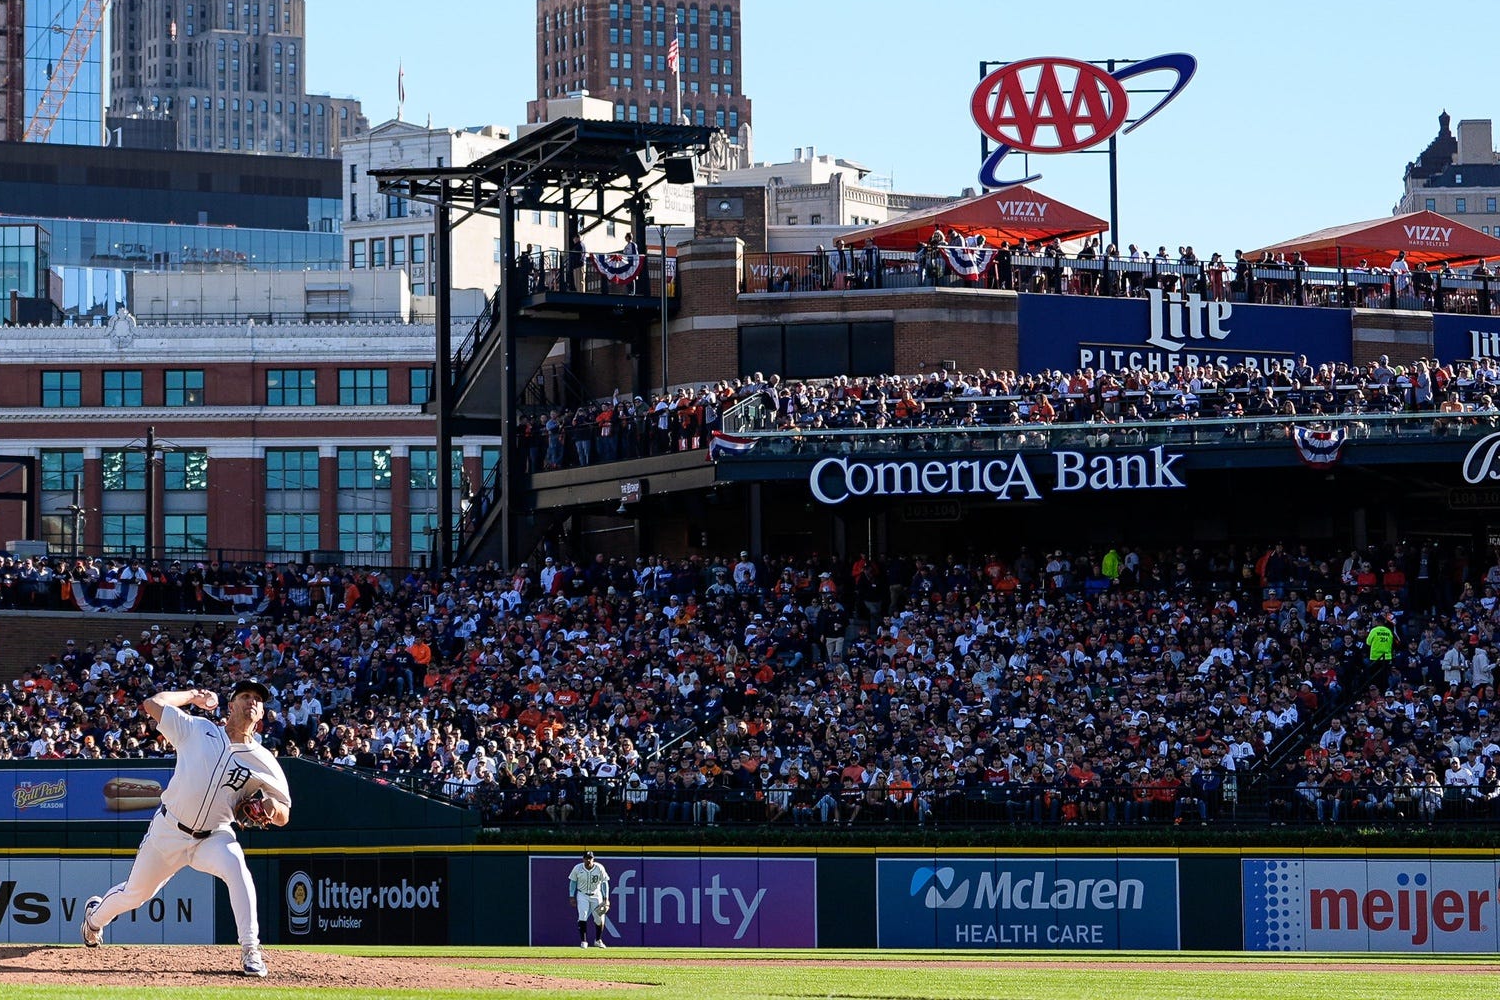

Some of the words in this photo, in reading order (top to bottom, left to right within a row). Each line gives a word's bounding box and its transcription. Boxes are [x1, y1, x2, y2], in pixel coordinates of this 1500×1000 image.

[985, 61, 1115, 149] AAA
[996, 201, 1048, 216] VIZZY
[1403, 225, 1453, 241] VIZZY
[1145, 288, 1232, 351] Lite
[1469, 330, 1500, 361] Lit
[1080, 348, 1229, 373] PITCHER'S
[1245, 357, 1296, 378] PUB
[1052, 445, 1186, 491] Bank
[15, 784, 40, 806] Ball
[40, 779, 66, 798] Park
[587, 869, 768, 940] finity
[973, 871, 1145, 910] McLaren
[318, 915, 329, 931] by
[330, 915, 363, 929] whisker
[1310, 873, 1490, 946] meijer
[955, 924, 1038, 944] HEALTH
[1046, 924, 1104, 944] CARE
